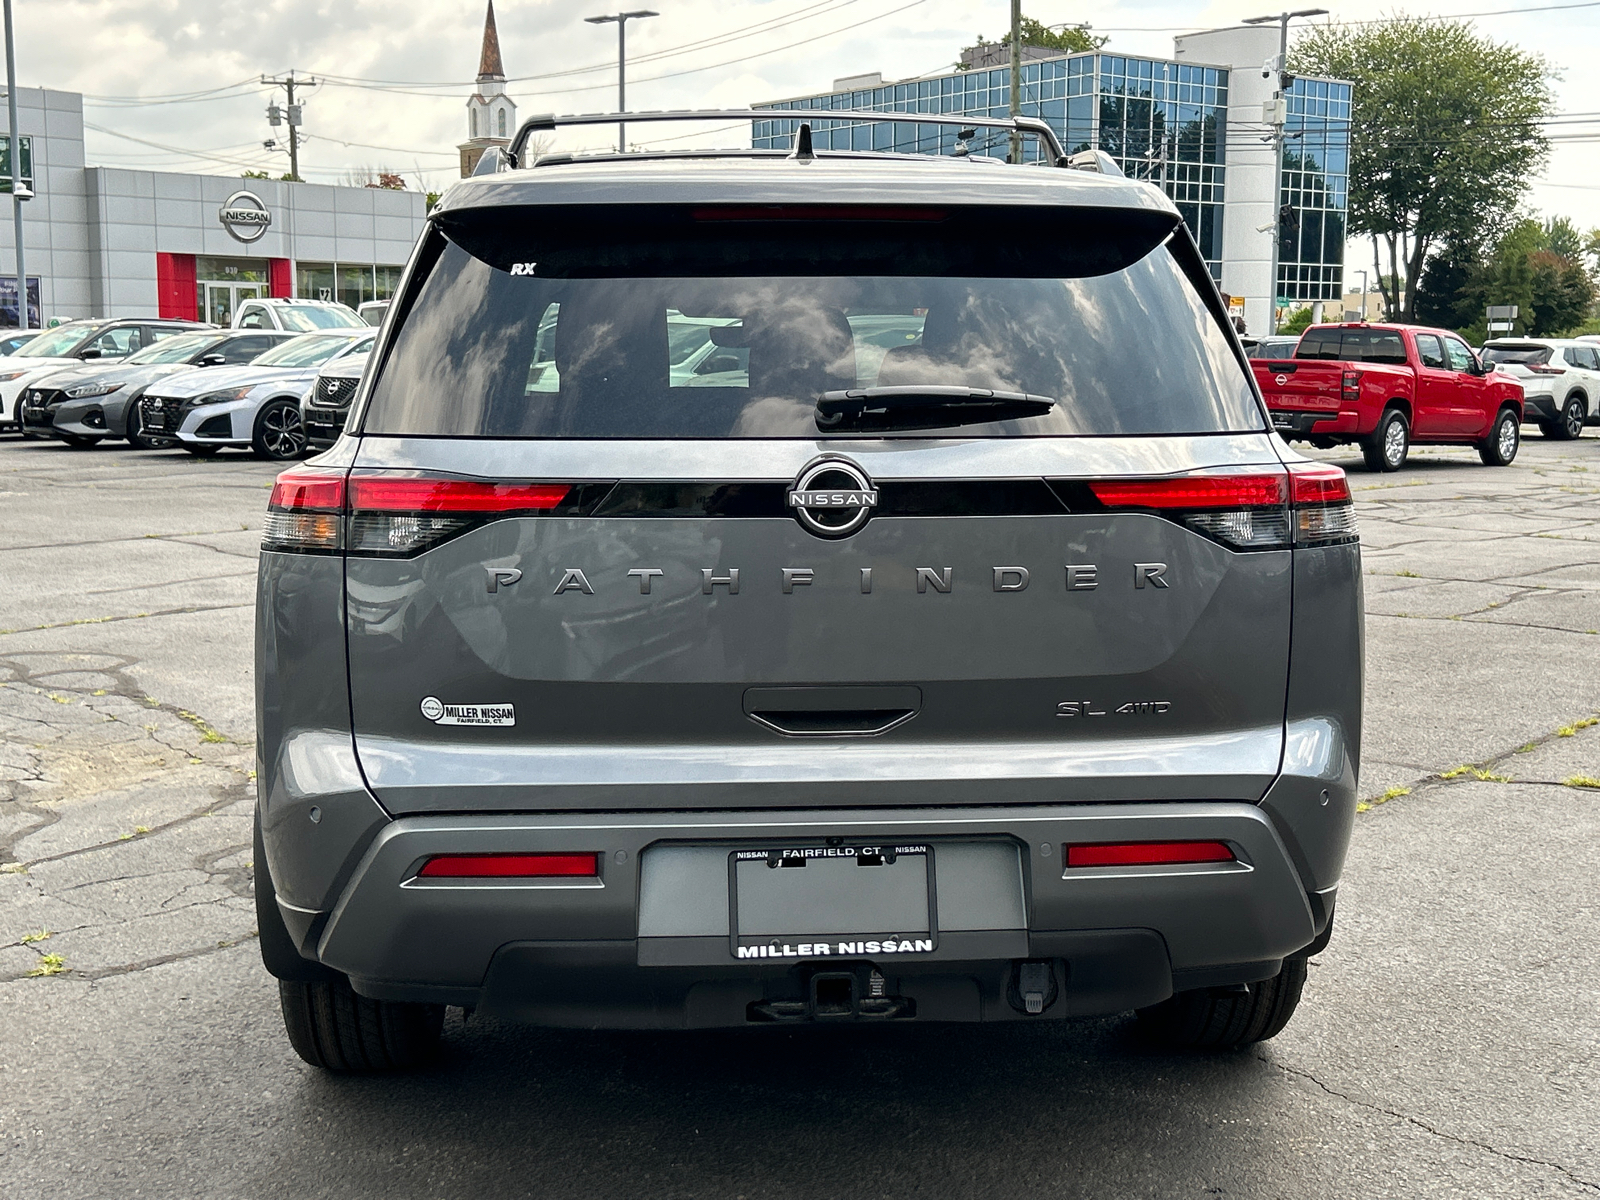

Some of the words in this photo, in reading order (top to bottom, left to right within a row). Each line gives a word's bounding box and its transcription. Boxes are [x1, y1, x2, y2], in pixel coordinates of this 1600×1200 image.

[225, 211, 269, 222] NISSAN
[510, 262, 537, 276] RX
[791, 493, 876, 505] NISSAN
[484, 561, 1170, 595] PATHFINDER
[446, 706, 478, 718] MILLER
[481, 708, 513, 719] NISSAN
[1055, 701, 1107, 717] SL
[737, 850, 769, 859] NISSAN
[782, 847, 858, 859] FAIRFIELD,
[862, 846, 882, 856] CT
[895, 845, 927, 854] NISSAN
[737, 943, 831, 959] MILLER
[838, 939, 932, 955] NISSAN
